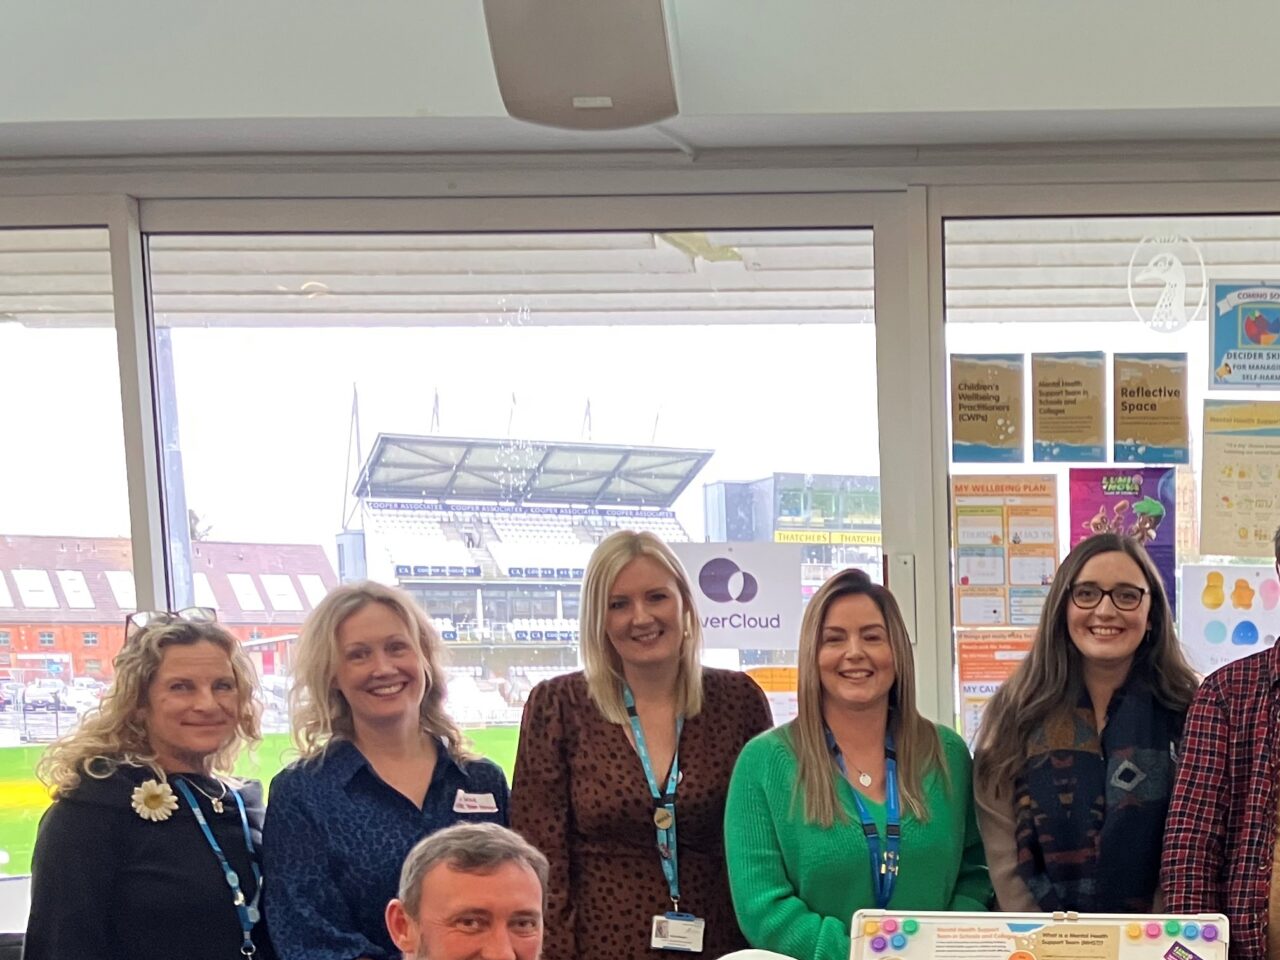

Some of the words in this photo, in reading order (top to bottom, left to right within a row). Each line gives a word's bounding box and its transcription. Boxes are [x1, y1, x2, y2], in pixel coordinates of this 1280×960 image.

[1226, 352, 1263, 360] DECIDER
[958, 383, 999, 391] Children's
[1120, 386, 1180, 398] Reflective
[958, 393, 1000, 403] Wellbeing
[1121, 401, 1157, 414] Space
[971, 484, 1020, 492] WELLBEING
[1023, 484, 1046, 492] PLAN
[779, 533, 827, 541] THATCHERS
[840, 534, 881, 543] THATCHE
[702, 614, 780, 628] verCloud
